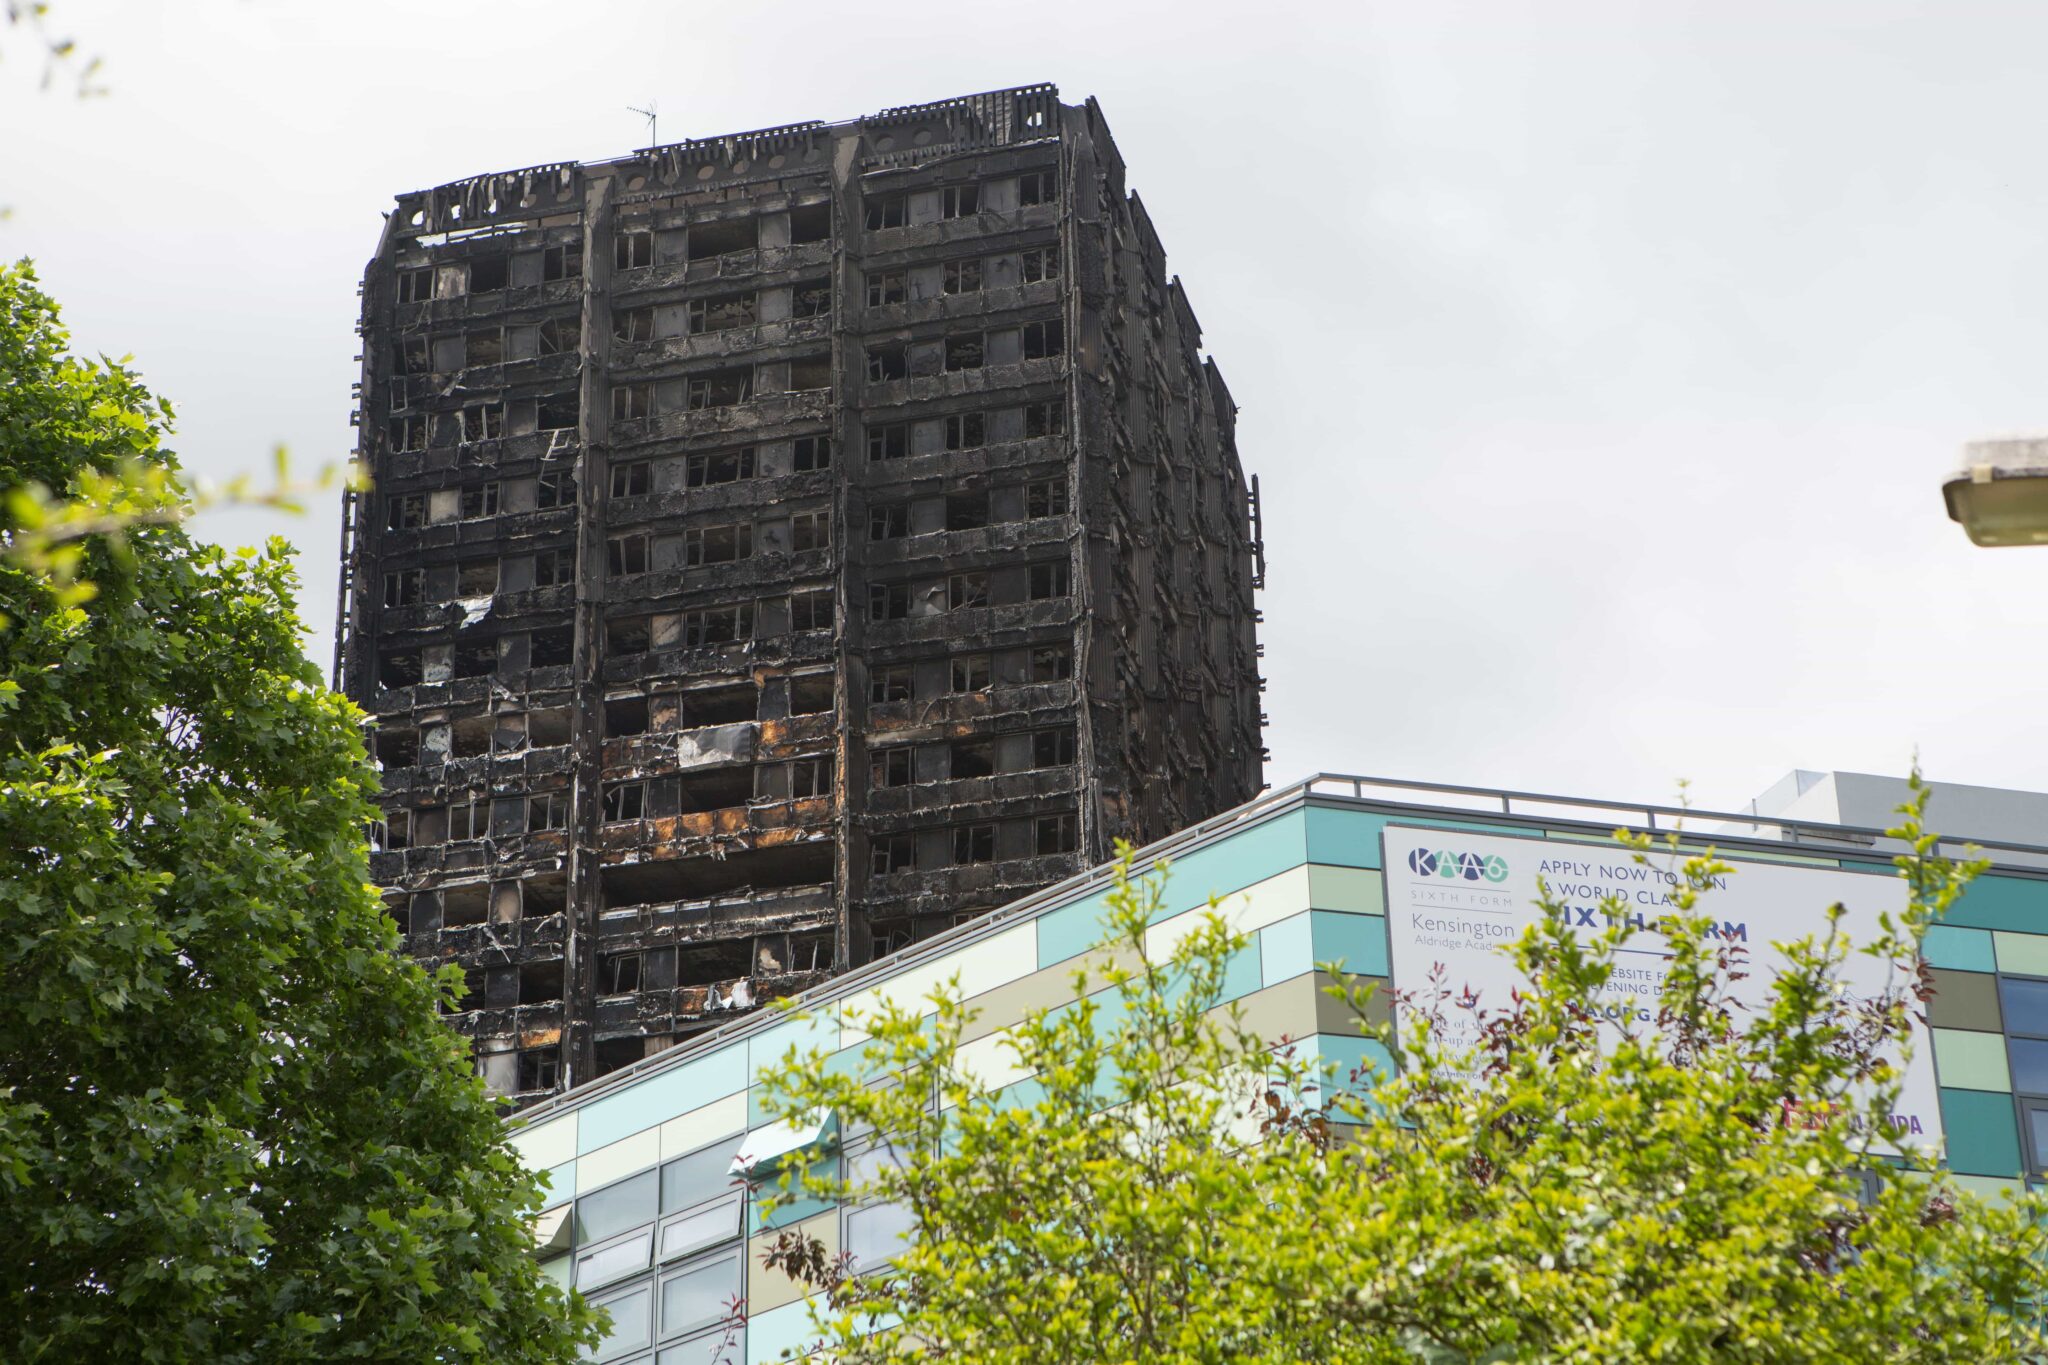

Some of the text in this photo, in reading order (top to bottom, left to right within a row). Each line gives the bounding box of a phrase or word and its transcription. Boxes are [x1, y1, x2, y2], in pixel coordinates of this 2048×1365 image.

[1409, 848, 1509, 883] KAA6
[1539, 860, 1591, 877] APPLY
[1600, 865, 1648, 882] NOW
[1653, 870, 1678, 886] TO
[1411, 890, 1512, 907] SIXTH FORM
[1559, 883, 1628, 902] WORLD
[1637, 890, 1685, 908] CLA
[1412, 913, 1515, 939] Kensington
[1553, 905, 1748, 942] IXTH RM
[1414, 934, 1462, 950] Aldridge
[1610, 967, 1652, 981] EBSITE
[1591, 981, 1648, 995] EENING
